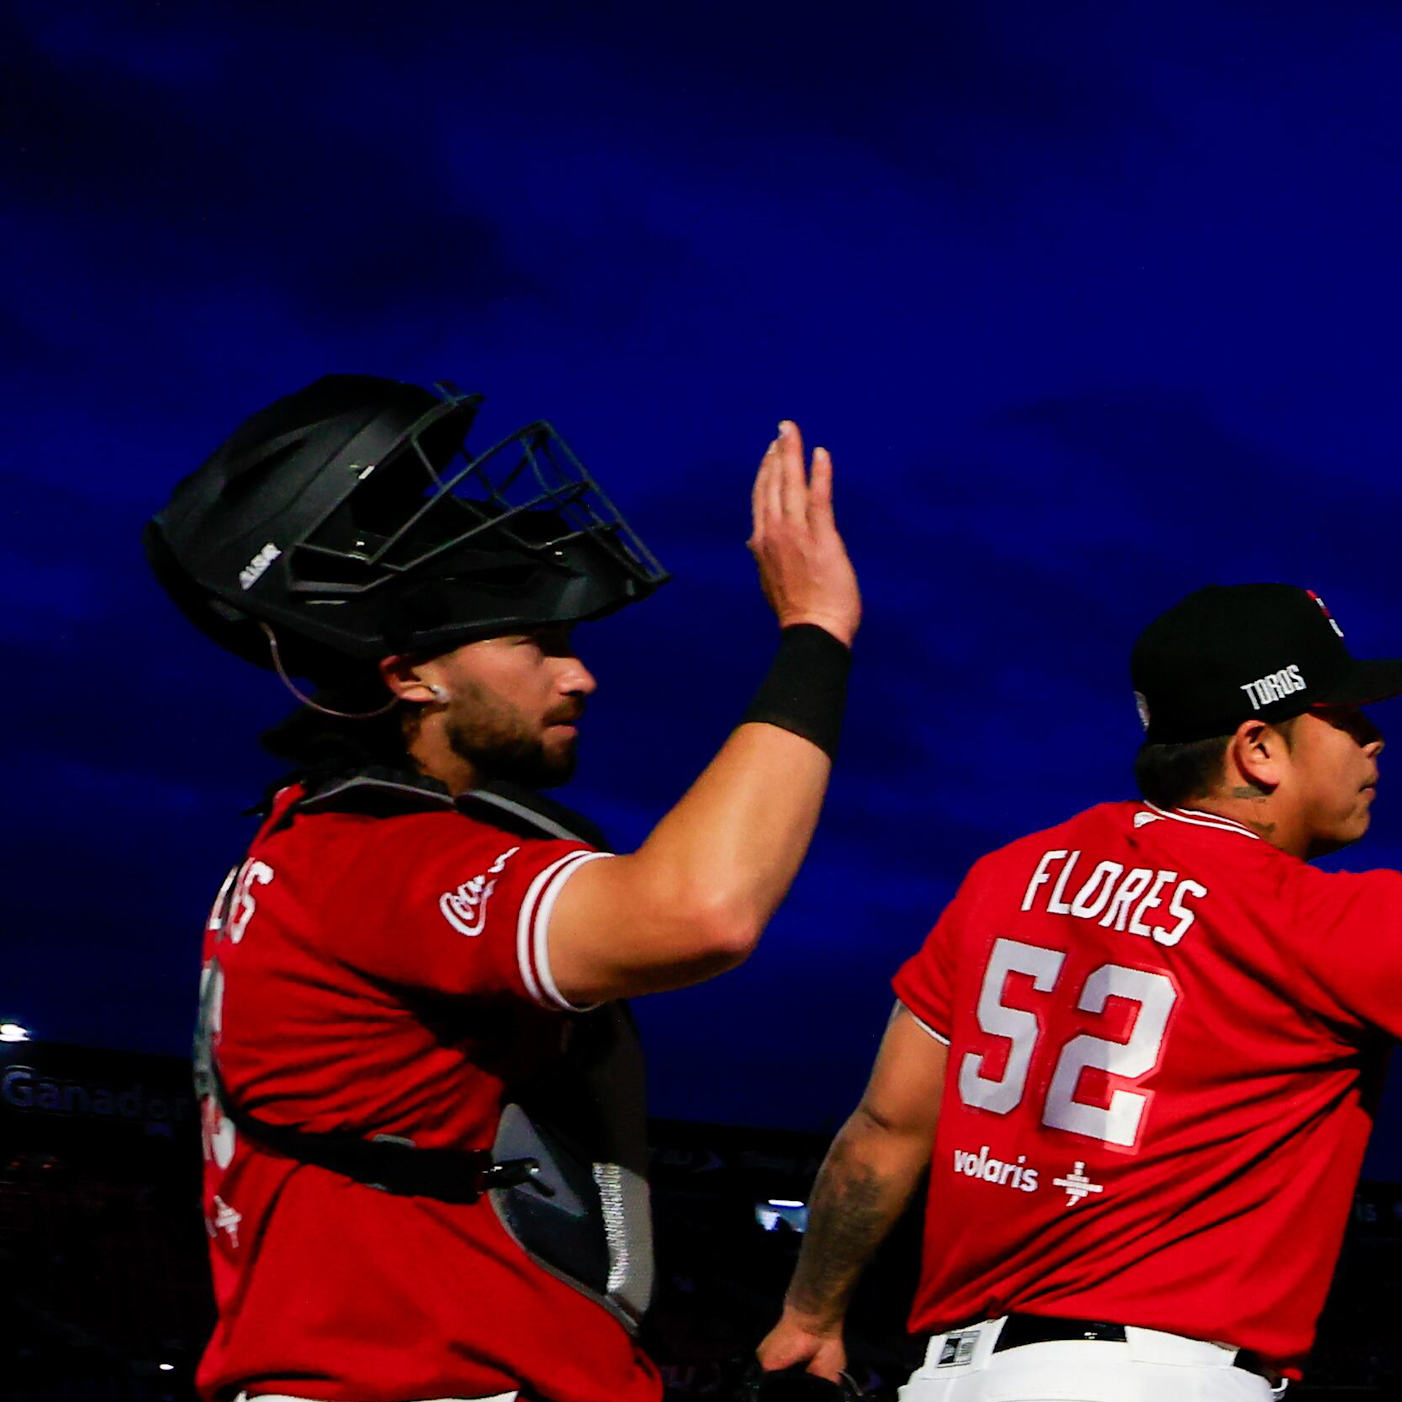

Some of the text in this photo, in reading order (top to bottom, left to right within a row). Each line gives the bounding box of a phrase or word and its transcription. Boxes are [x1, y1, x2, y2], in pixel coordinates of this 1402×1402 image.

[1240, 664, 1307, 710] TOROS
[1021, 849, 1208, 946] FLORES
[958, 938, 1180, 1150] 52
[954, 1146, 1038, 1192] volaris
